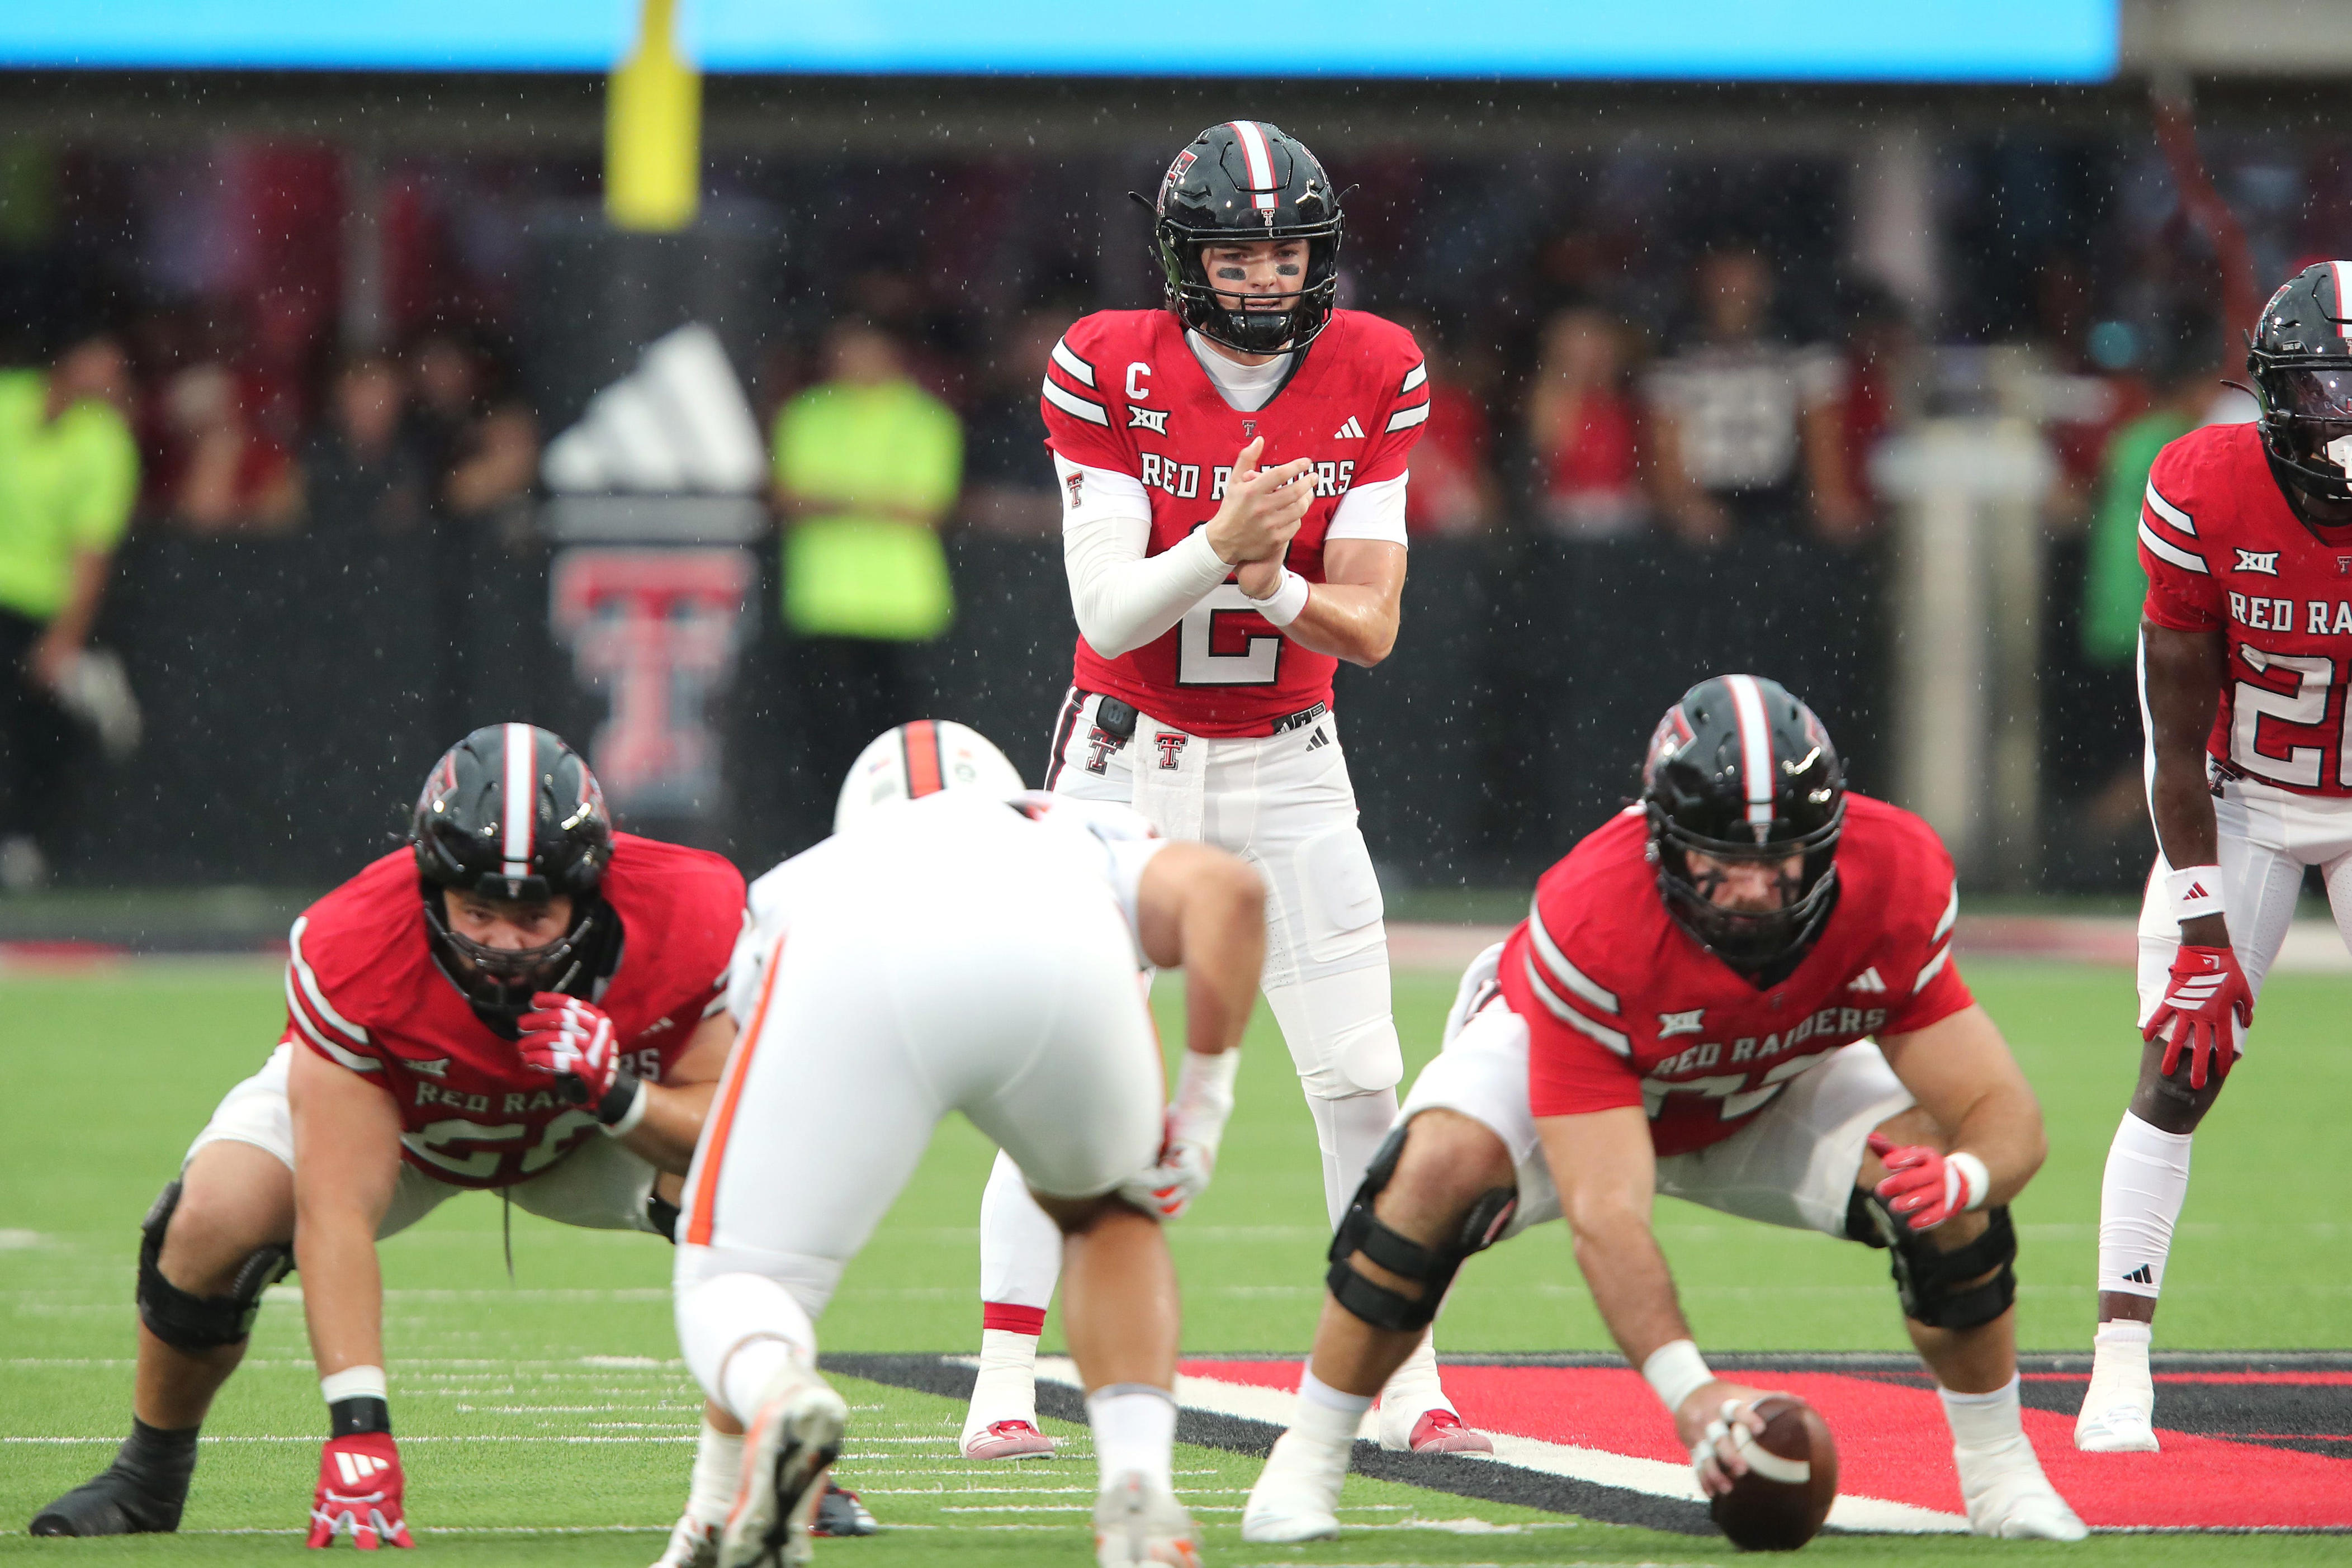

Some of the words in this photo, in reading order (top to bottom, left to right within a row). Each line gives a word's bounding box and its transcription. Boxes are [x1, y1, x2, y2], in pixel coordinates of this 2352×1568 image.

[1125, 362, 1151, 400] C
[1127, 405, 1169, 436] XII
[1141, 452, 1200, 499] RED
[2233, 548, 2280, 576] XII
[2228, 590, 2293, 632] RED
[2230, 643, 2352, 787] 2
[1651, 1043, 1722, 1076] RED
[1730, 1007, 1887, 1062] RAIDERS
[415, 1080, 490, 1114] RED
